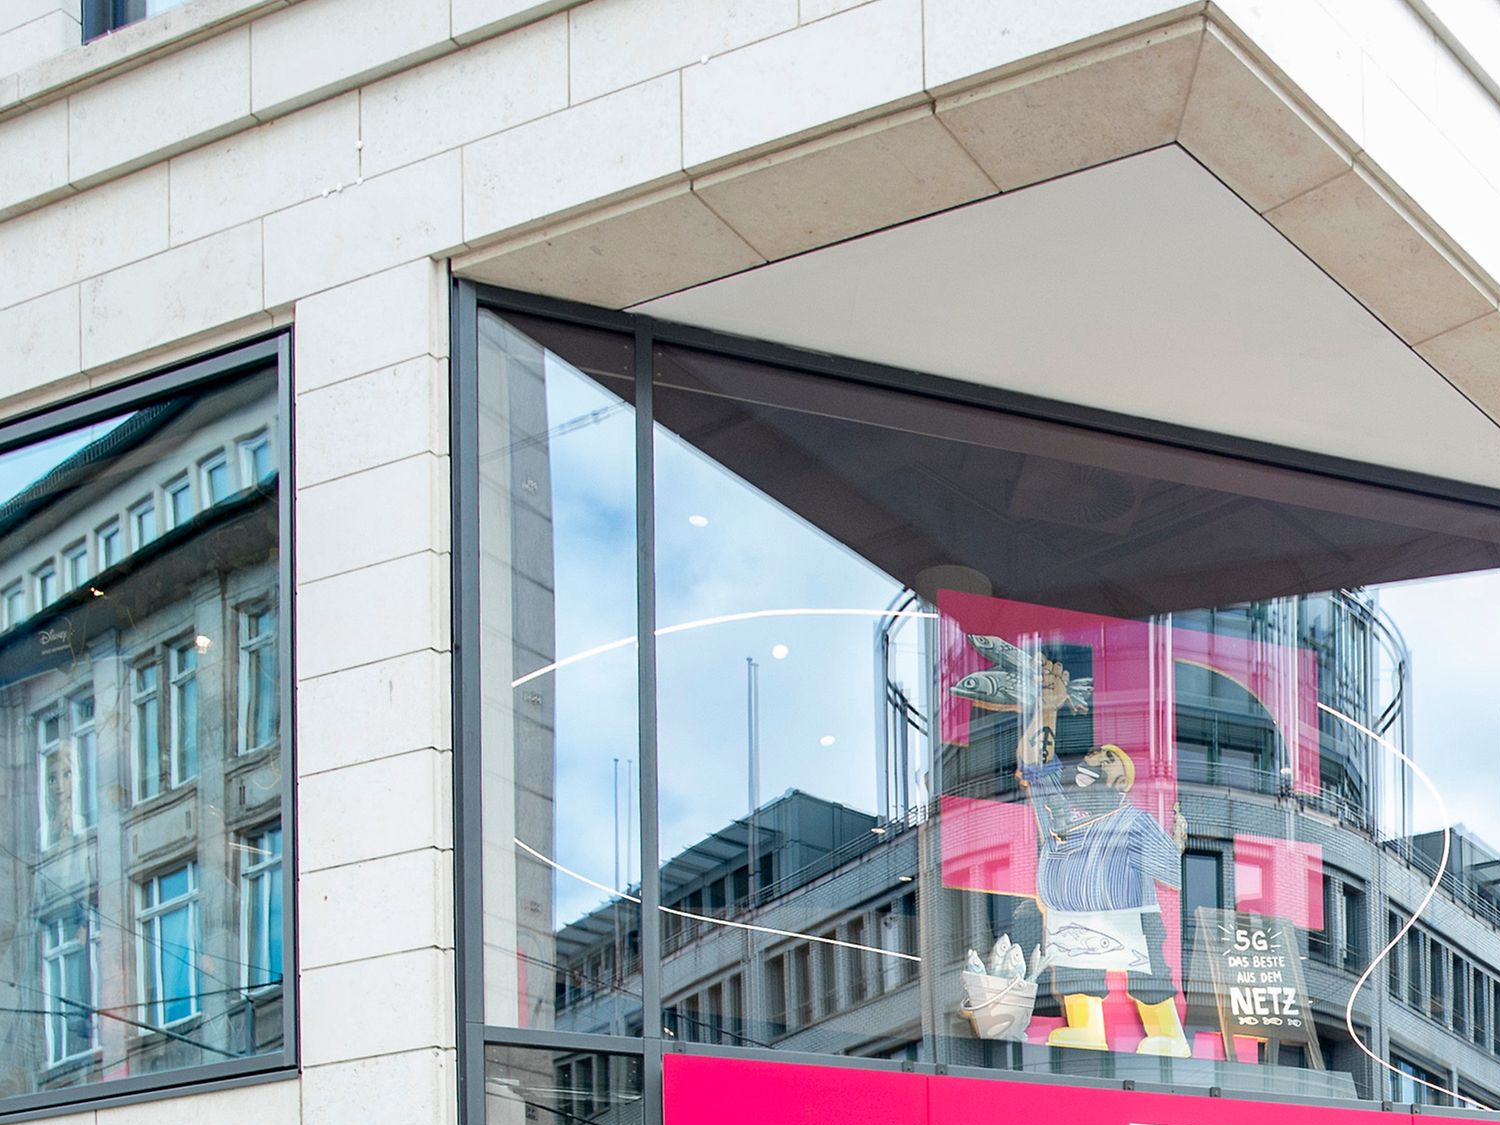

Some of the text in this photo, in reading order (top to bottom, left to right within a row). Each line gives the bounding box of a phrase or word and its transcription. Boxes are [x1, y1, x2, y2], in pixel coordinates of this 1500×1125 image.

[1234, 930, 1268, 951] 5G
[1229, 955, 1286, 968] DAS BESTE
[1237, 971, 1282, 984] AUS DEM
[1230, 987, 1299, 1016] NETZ
